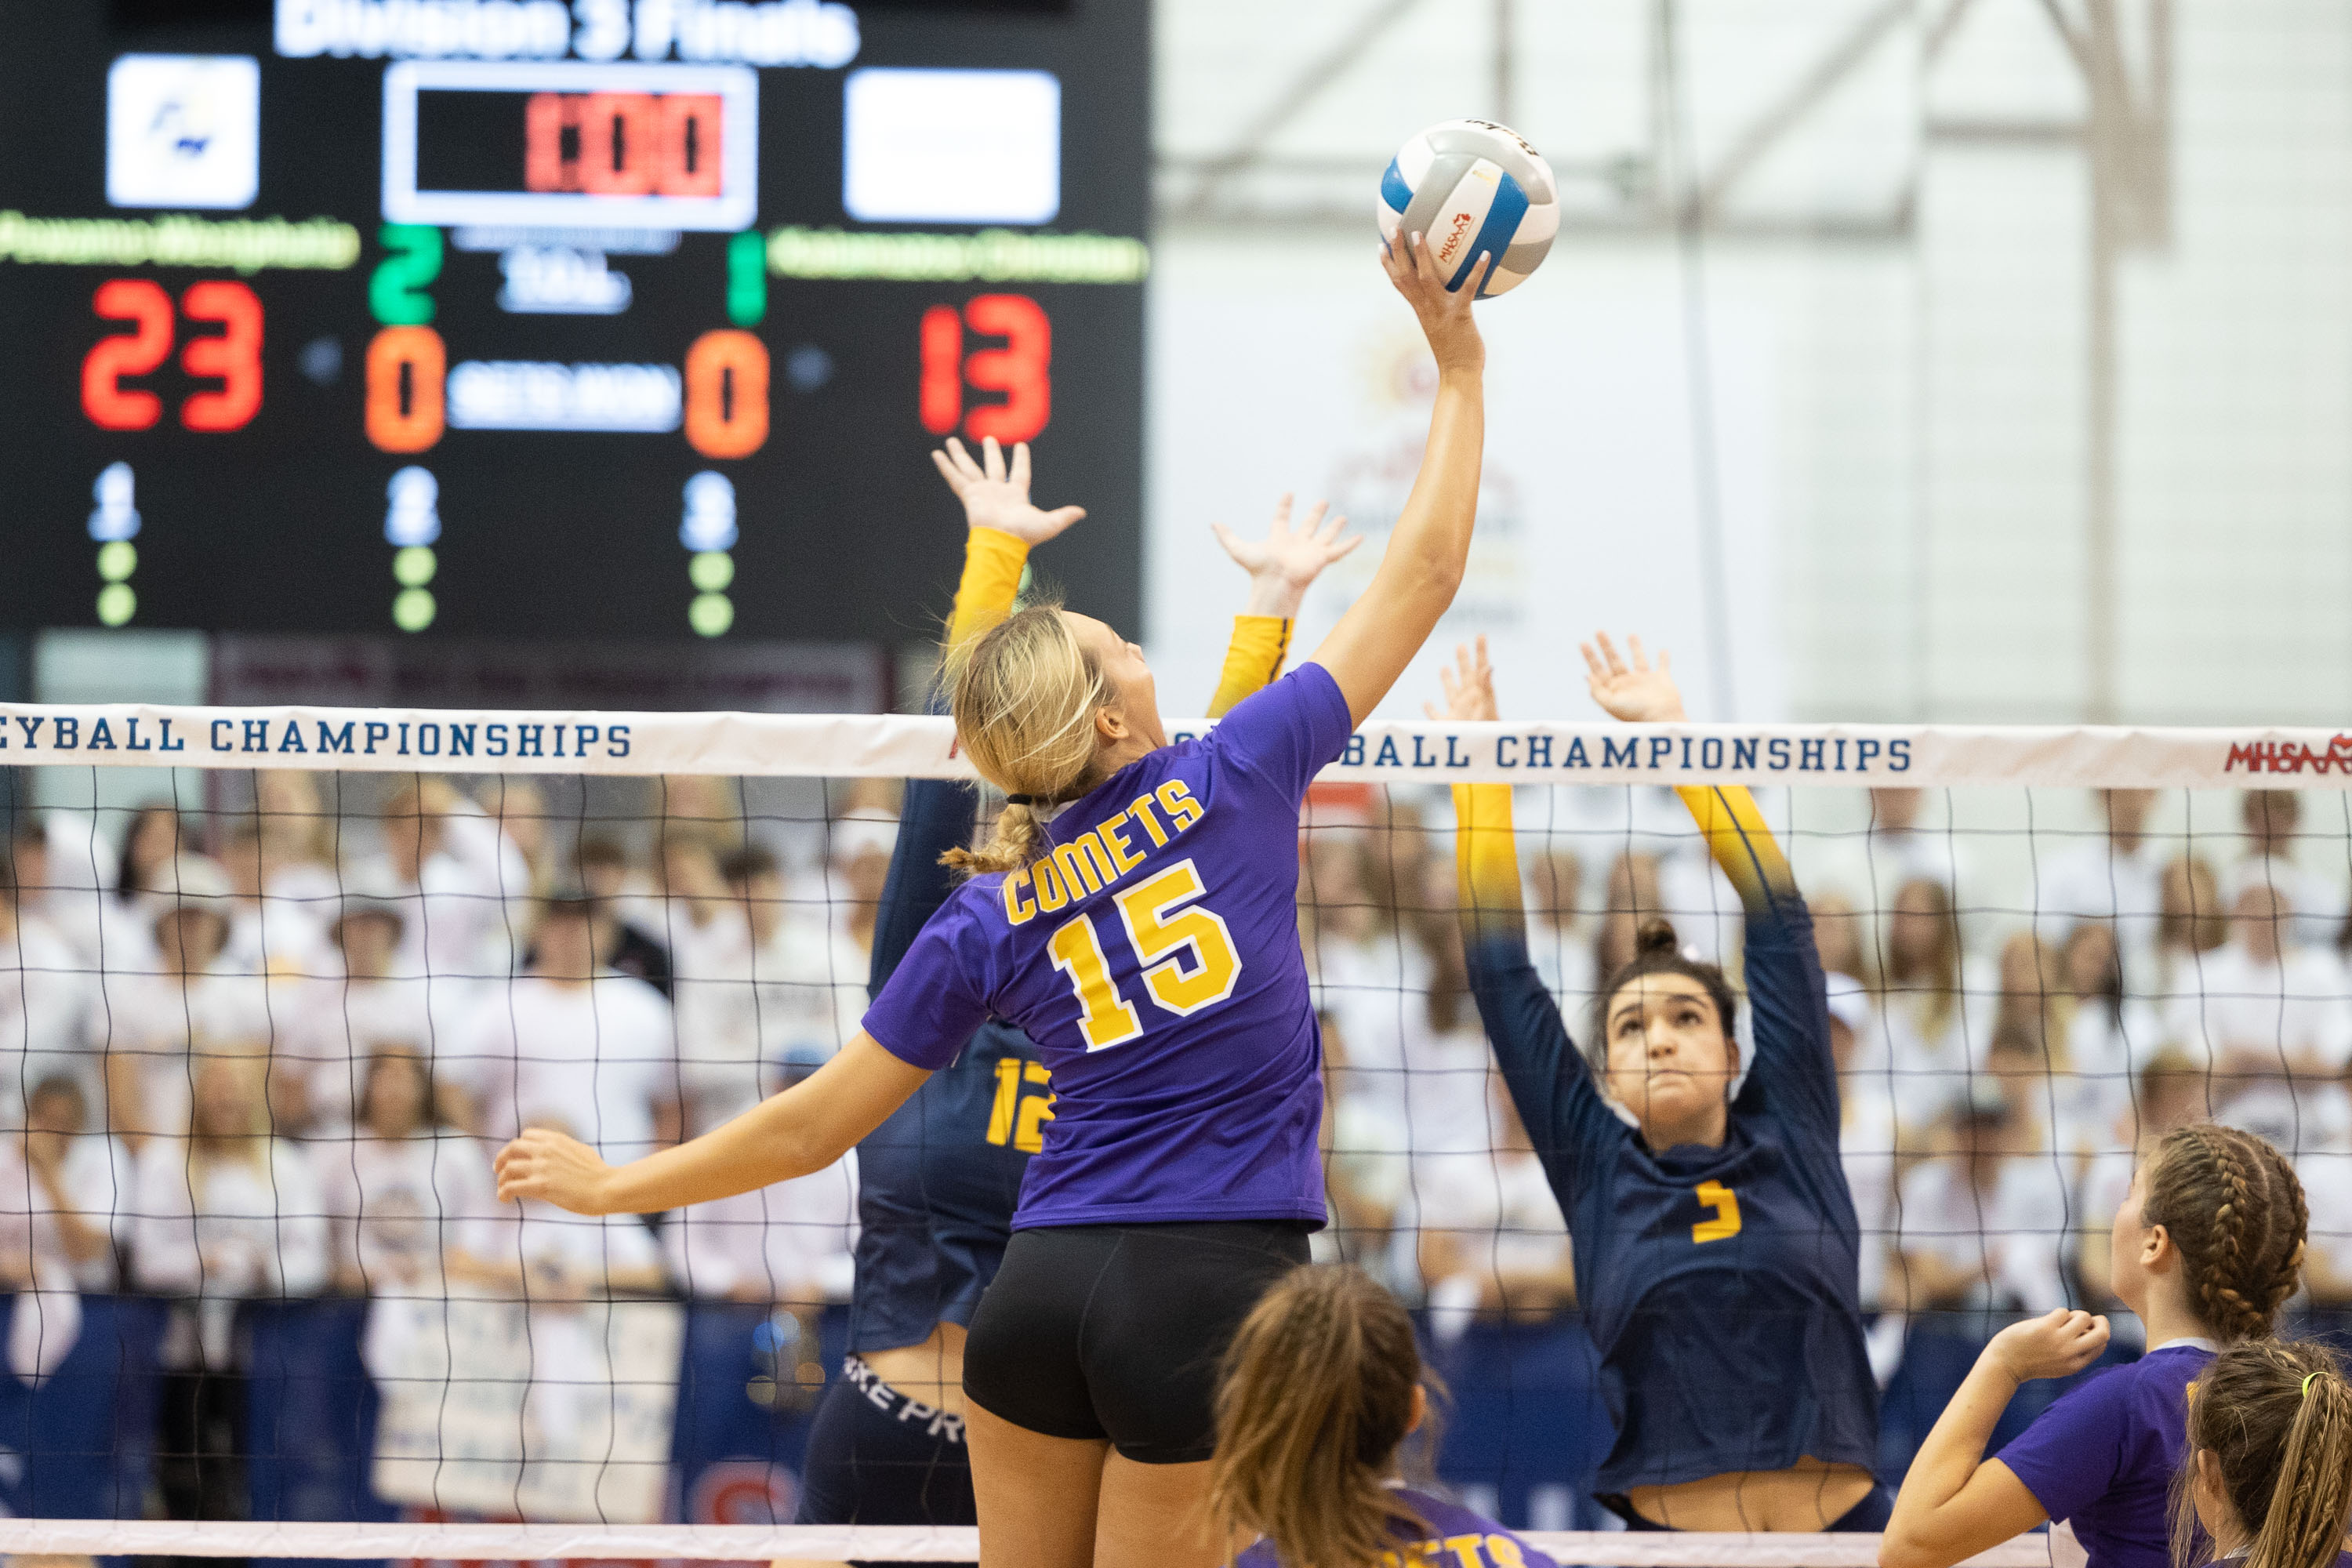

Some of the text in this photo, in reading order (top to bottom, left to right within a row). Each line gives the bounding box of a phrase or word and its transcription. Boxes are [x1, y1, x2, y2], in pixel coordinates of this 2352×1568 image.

[368, 223, 444, 325] 2
[727, 230, 768, 327] 1
[81, 278, 265, 433] 23
[365, 325, 447, 454] 0
[684, 328, 771, 459] 0
[920, 293, 1052, 446] 13
[0, 716, 632, 758] YBALL CHAMPIONSHIPS
[1341, 734, 1913, 771] BALL CHAMPIONSHIPS
[1004, 779, 1205, 926] COMETS
[1046, 858, 1243, 1054] 15
